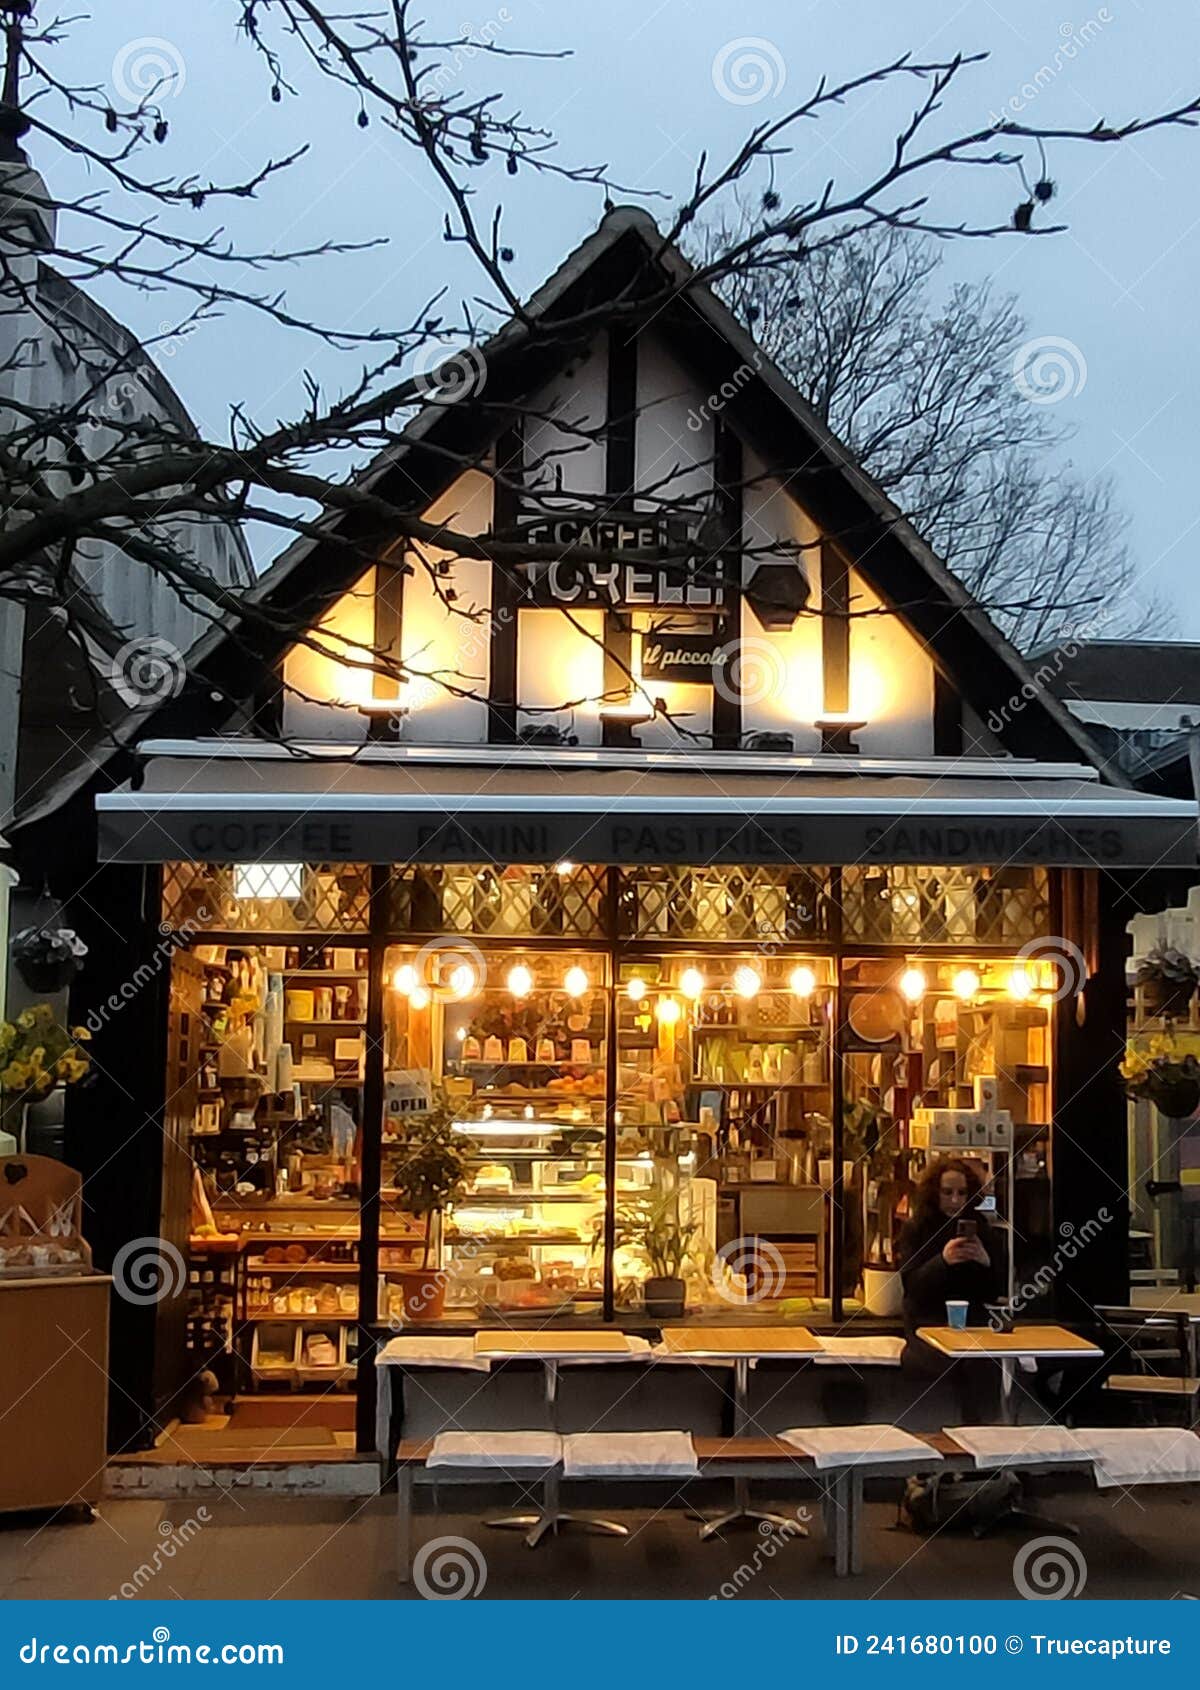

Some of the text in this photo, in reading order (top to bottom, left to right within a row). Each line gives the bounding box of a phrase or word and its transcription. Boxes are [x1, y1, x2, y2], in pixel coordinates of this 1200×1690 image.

[643, 645, 728, 670] il piccolo
[189, 823, 1124, 860] COFFEE PANINI PASTRIES SANDWICHES
[390, 1098, 427, 1113] OPEN
